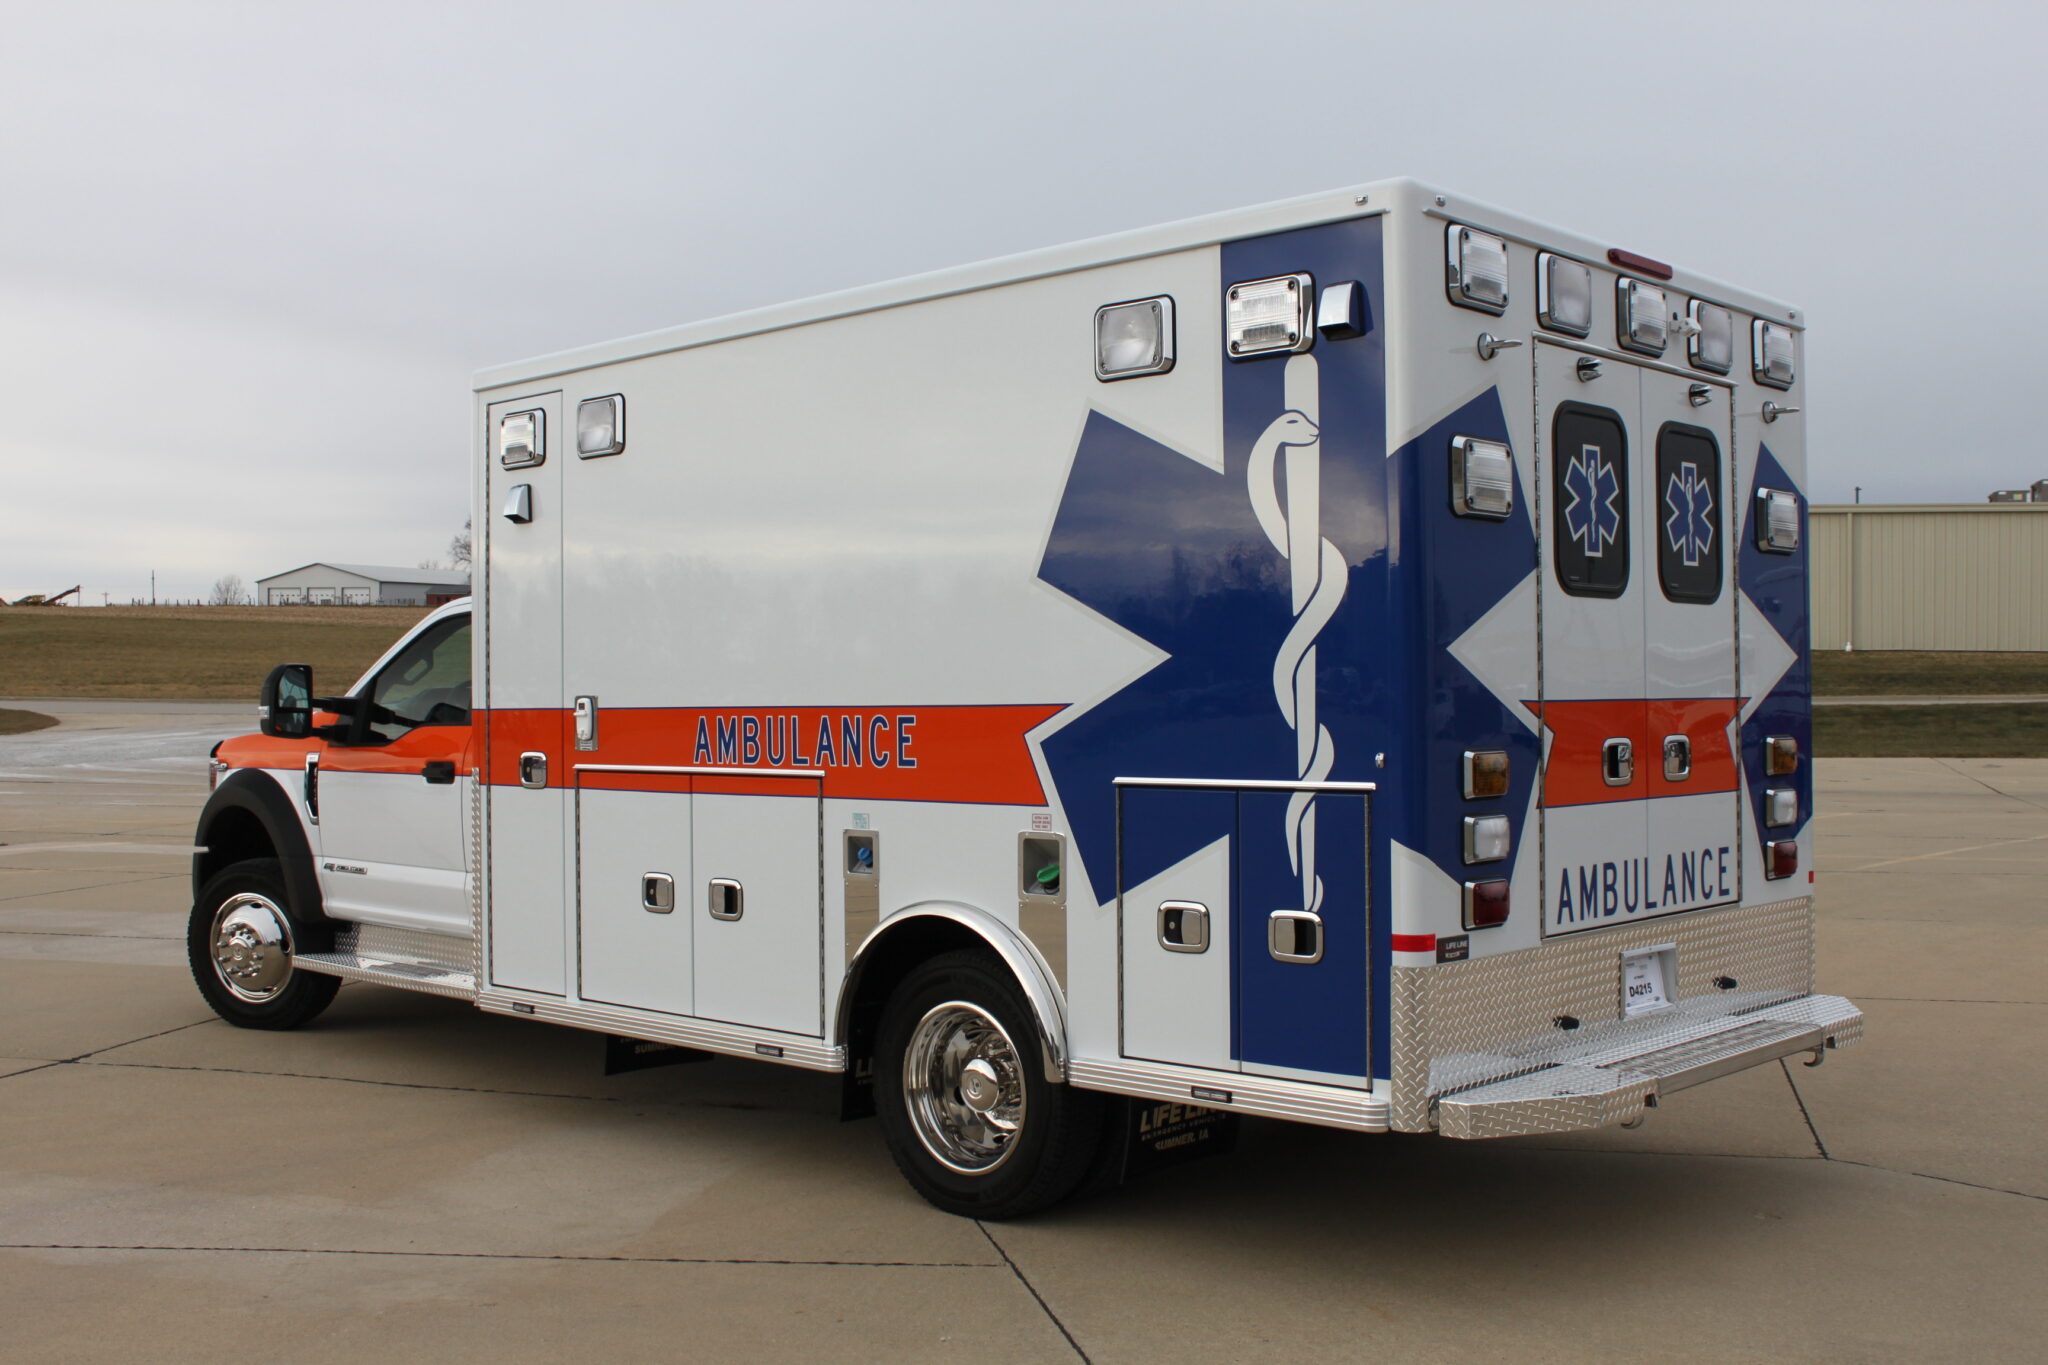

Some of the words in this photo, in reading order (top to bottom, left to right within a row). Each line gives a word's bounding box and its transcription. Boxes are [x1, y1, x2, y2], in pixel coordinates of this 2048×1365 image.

[693, 715, 917, 768] AMBULANCE
[1557, 846, 1730, 924] AMBULANCE
[1629, 982, 1653, 998] D4215
[1140, 1102, 1183, 1133] LIFE
